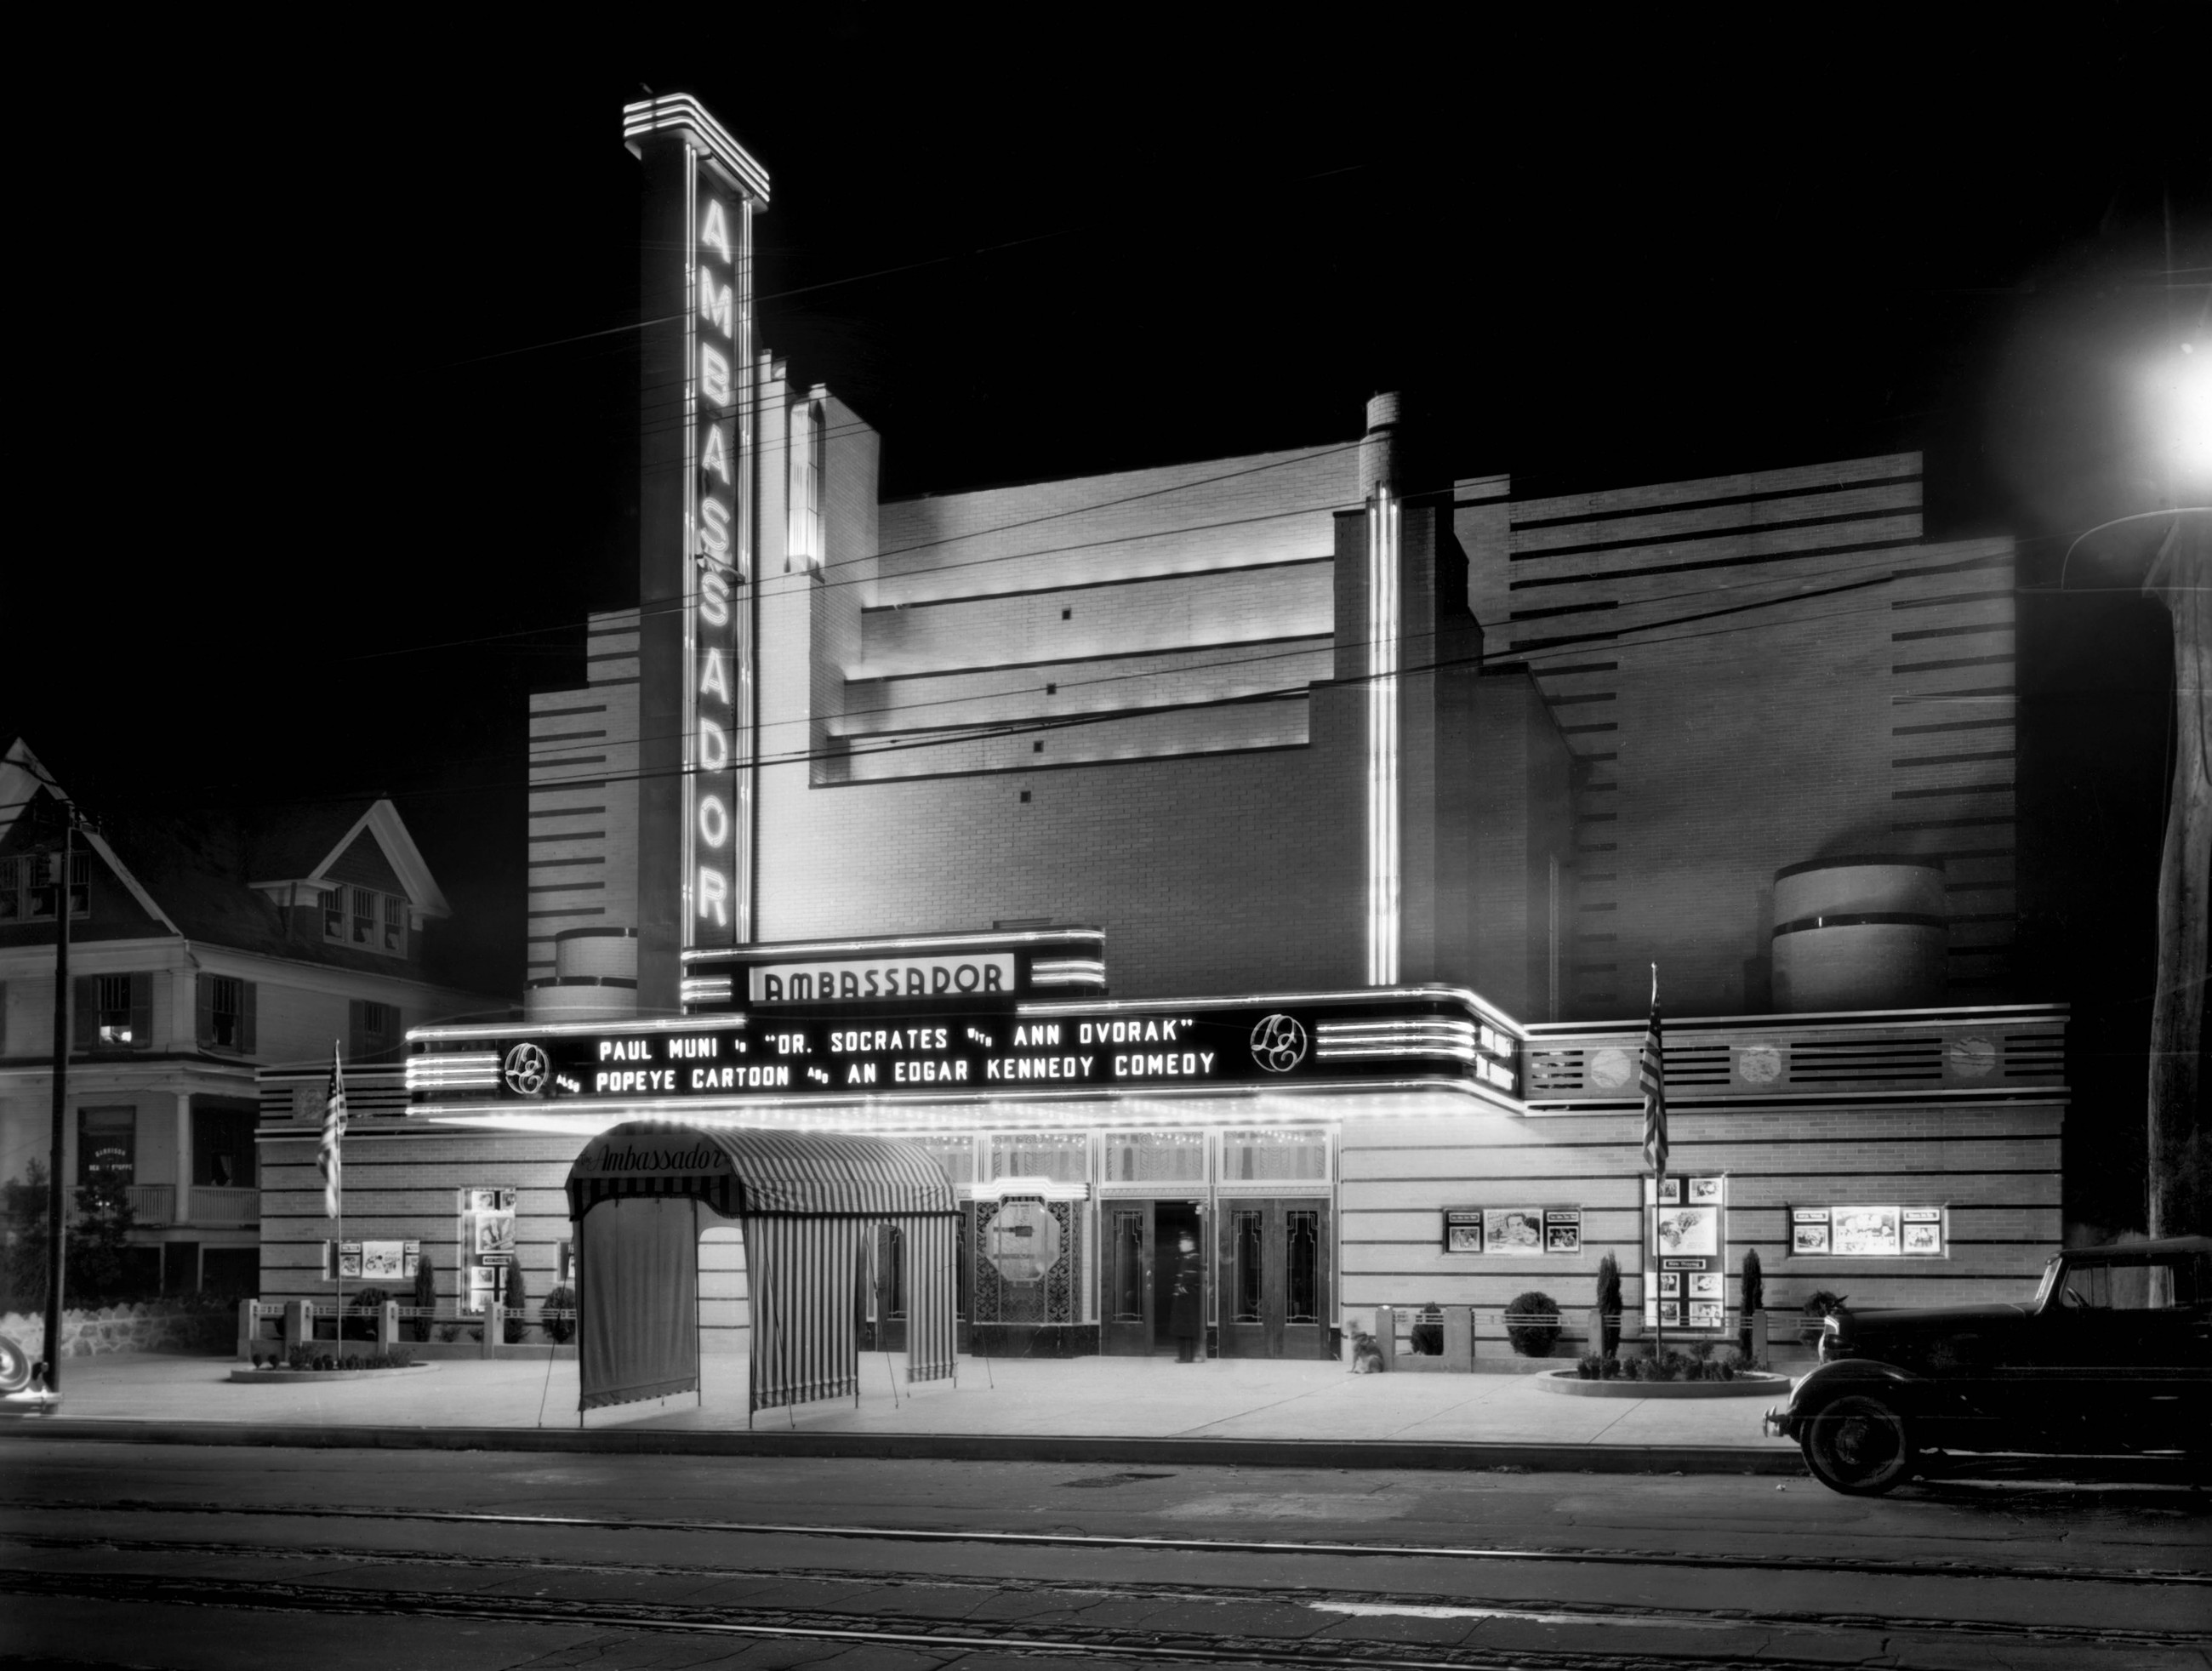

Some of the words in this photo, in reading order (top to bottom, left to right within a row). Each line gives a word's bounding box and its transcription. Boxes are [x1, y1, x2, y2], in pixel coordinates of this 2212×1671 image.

[700, 198, 732, 927] AMBASSADOR
[764, 963, 1004, 1001] AMBASSADOR
[599, 1040, 653, 1062] PAUL
[668, 1037, 717, 1059] MUNI
[830, 1028, 948, 1052] SOCRATES
[966, 1027, 993, 1047] WITH
[1013, 1023, 1060, 1047] ANN
[556, 1074, 581, 1093] ALSO
[596, 1069, 676, 1092] POPEYE
[692, 1065, 790, 1089] CARTOON
[807, 1066, 830, 1085] AND
[847, 1063, 876, 1084] AN
[894, 1059, 968, 1082] EDGAR
[987, 1056, 1094, 1080] KENNEDY
[1115, 1052, 1215, 1077] COMEDY
[587, 1142, 721, 1172] Ambassador
